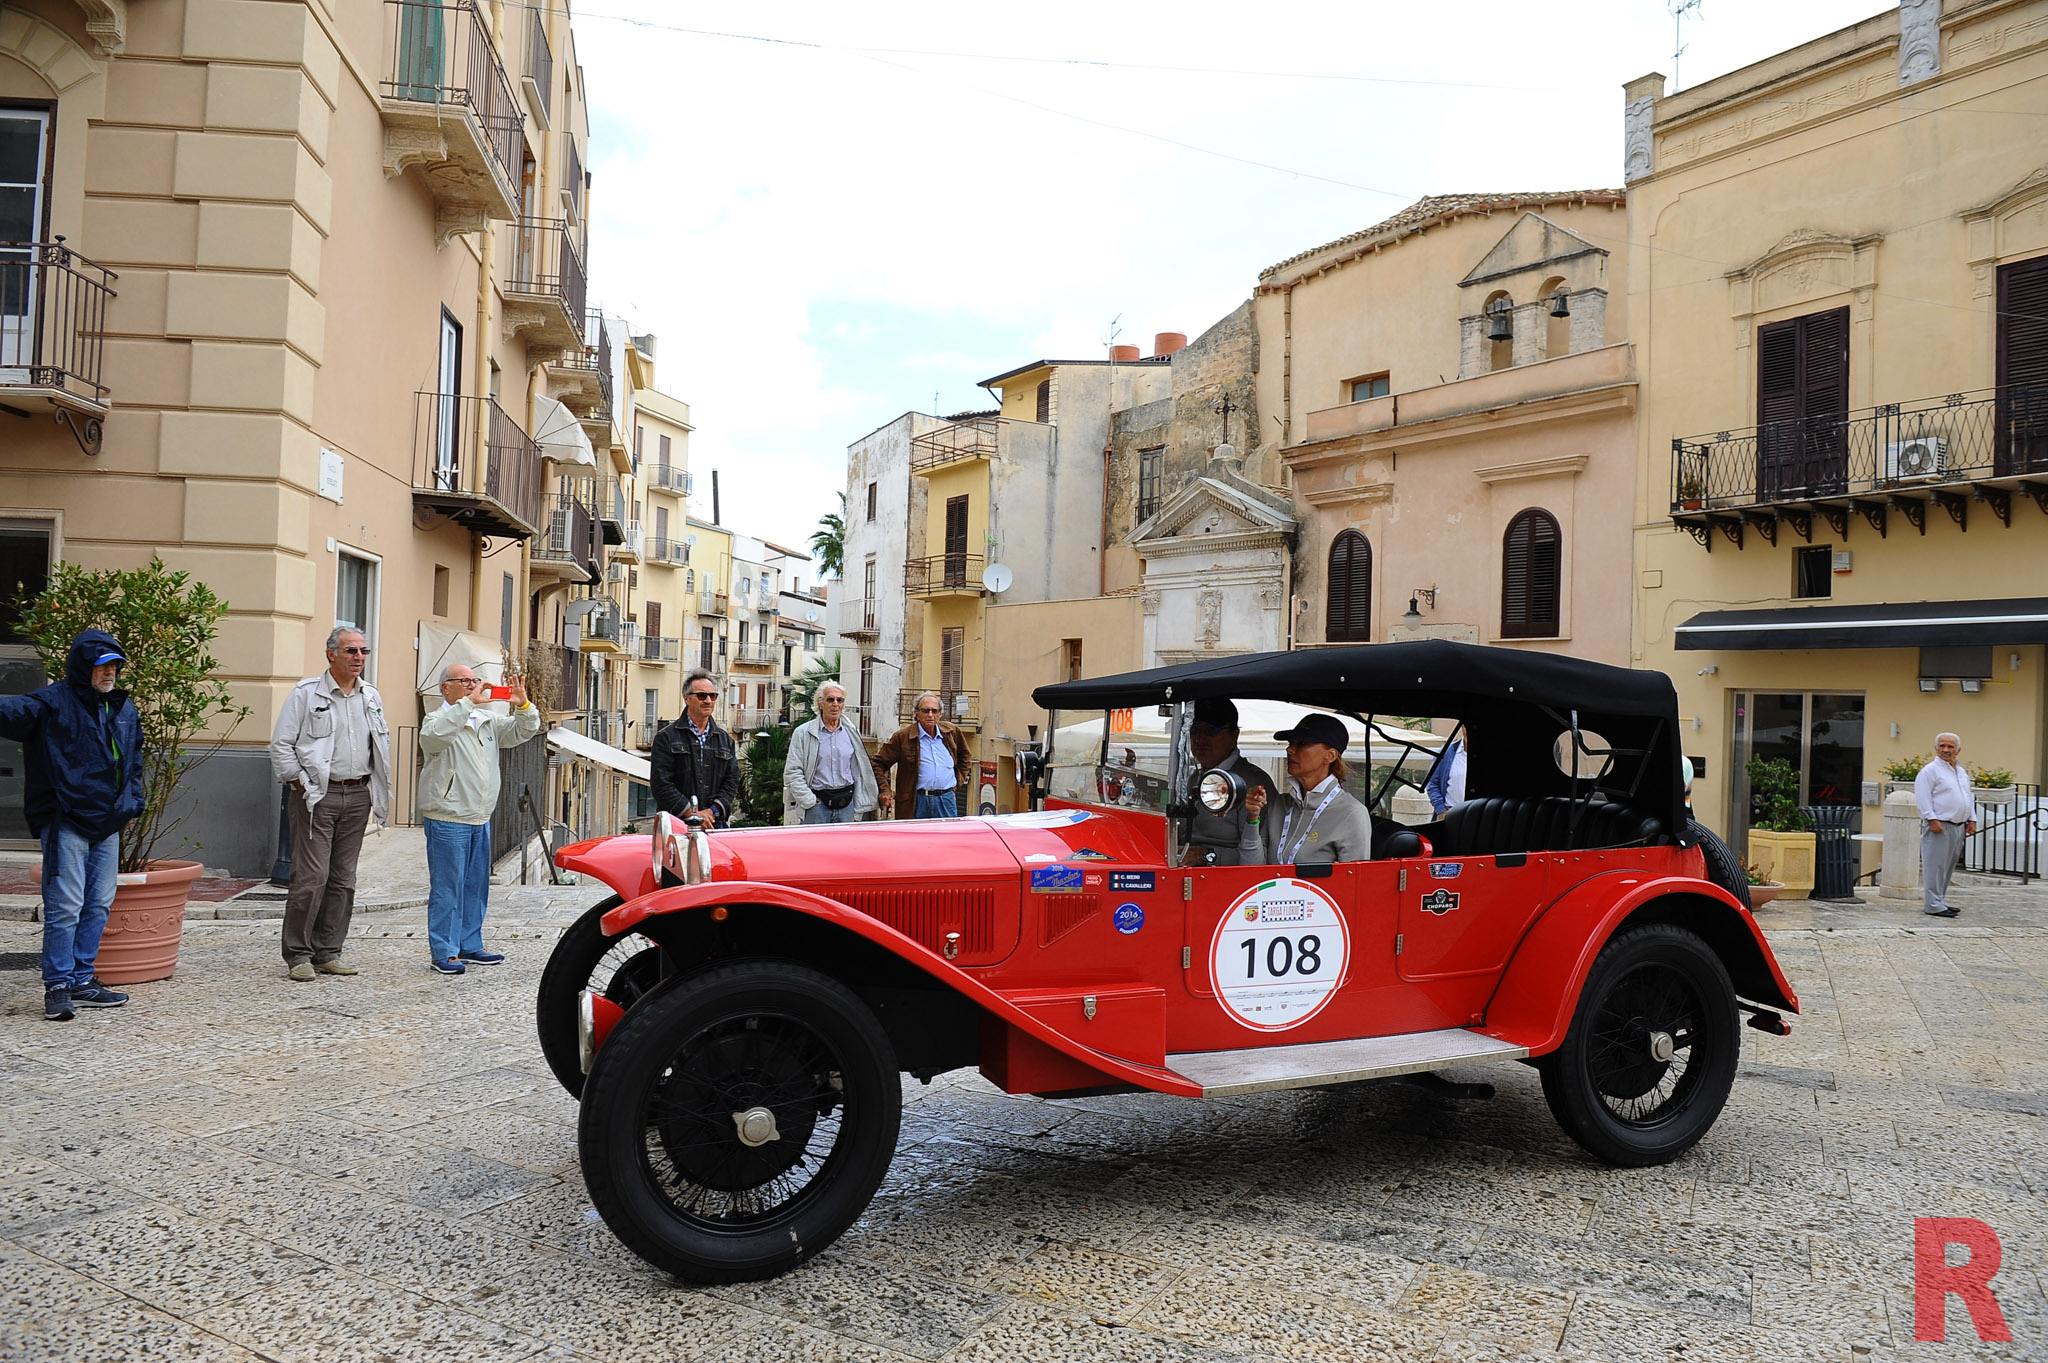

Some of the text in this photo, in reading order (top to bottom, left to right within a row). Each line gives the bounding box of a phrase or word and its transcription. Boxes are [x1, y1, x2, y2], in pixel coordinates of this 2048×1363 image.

[1110, 708, 1133, 734] 108
[1119, 911, 1138, 919] 2016
[1267, 906, 1283, 917] TARGA
[1283, 905, 1300, 916] FLORIO
[1240, 934, 1321, 979] 108
